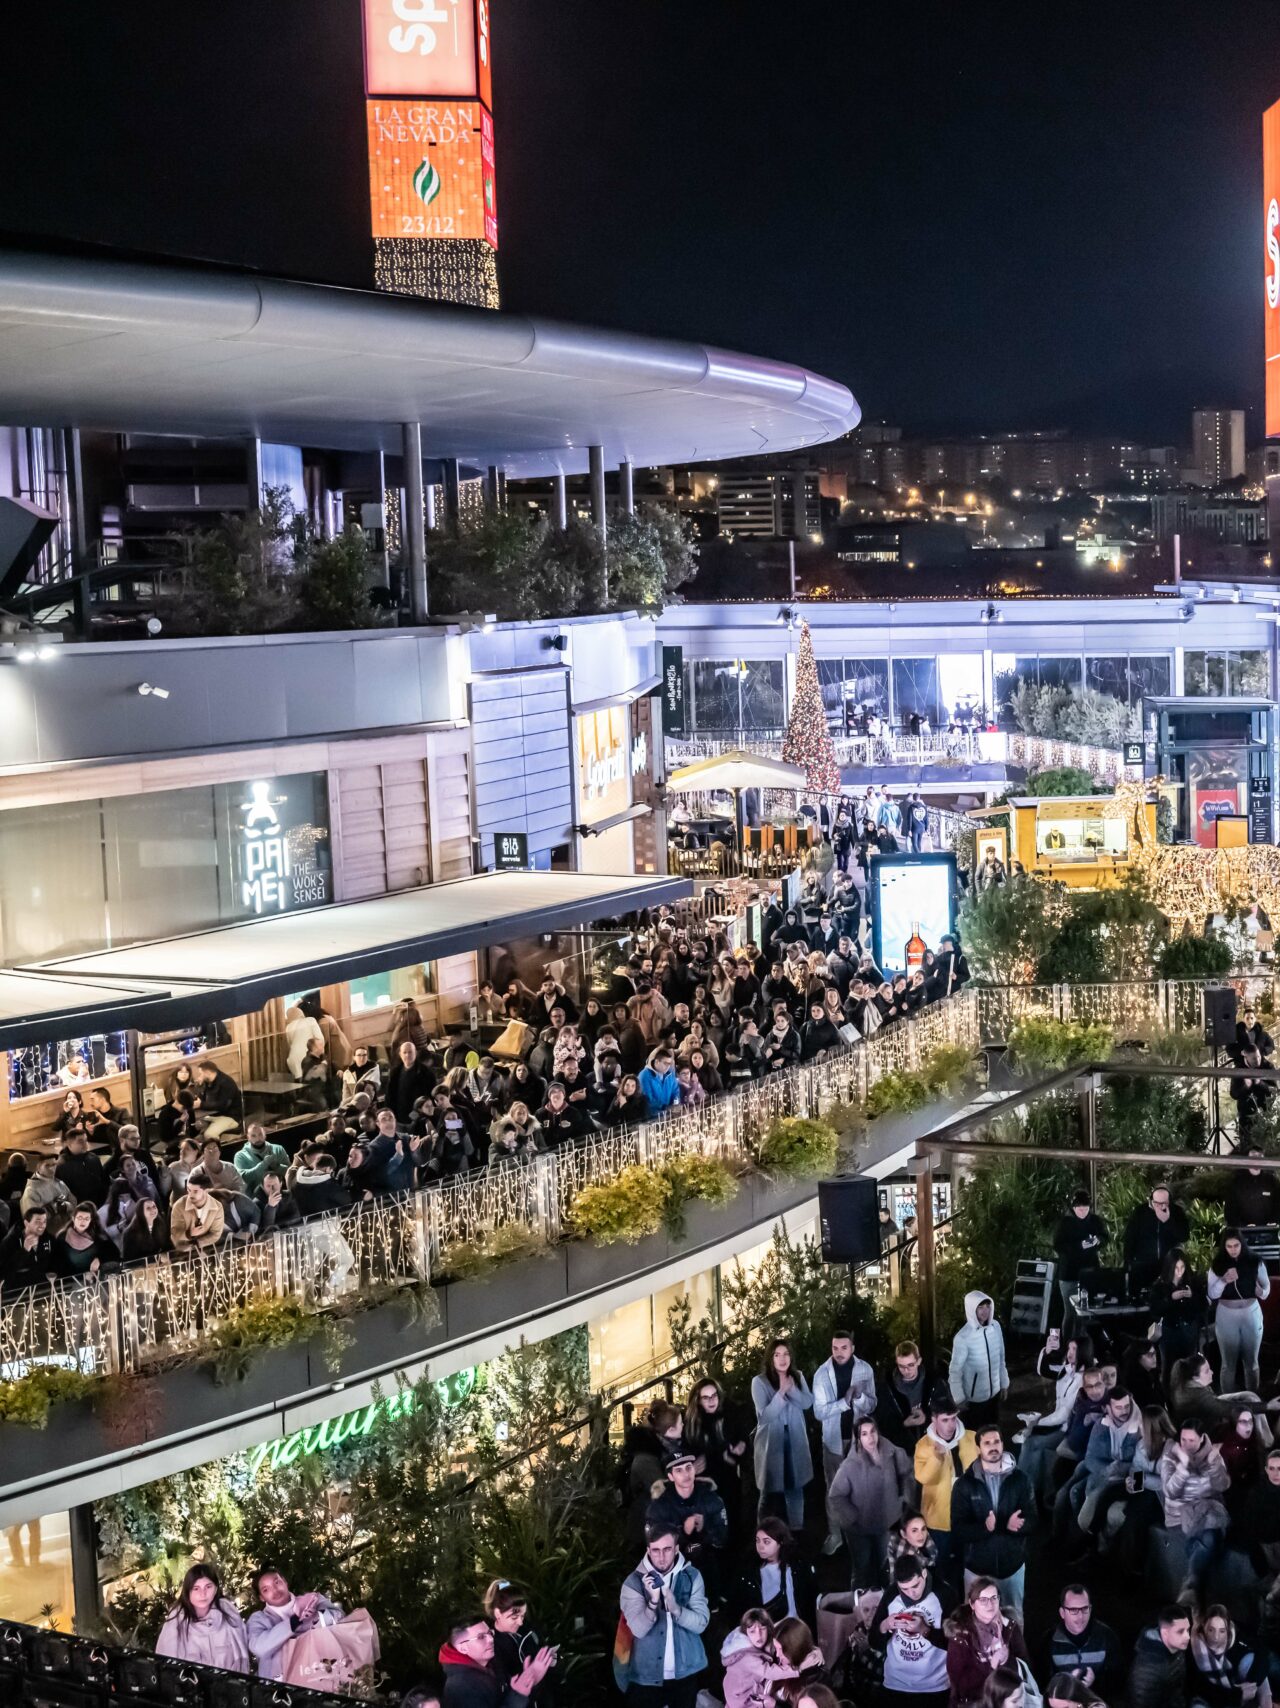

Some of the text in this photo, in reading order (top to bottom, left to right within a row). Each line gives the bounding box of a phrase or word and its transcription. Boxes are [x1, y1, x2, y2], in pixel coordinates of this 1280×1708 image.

[374, 106, 403, 125] LA
[407, 106, 473, 126] GRAN
[378, 124, 470, 143] NEVADA
[402, 216, 455, 234] 23/12
[246, 837, 290, 882] PAI
[293, 862, 311, 876] THE
[293, 873, 325, 890] WOK'S
[242, 872, 285, 914] MEI
[294, 886, 325, 904] SENSEI
